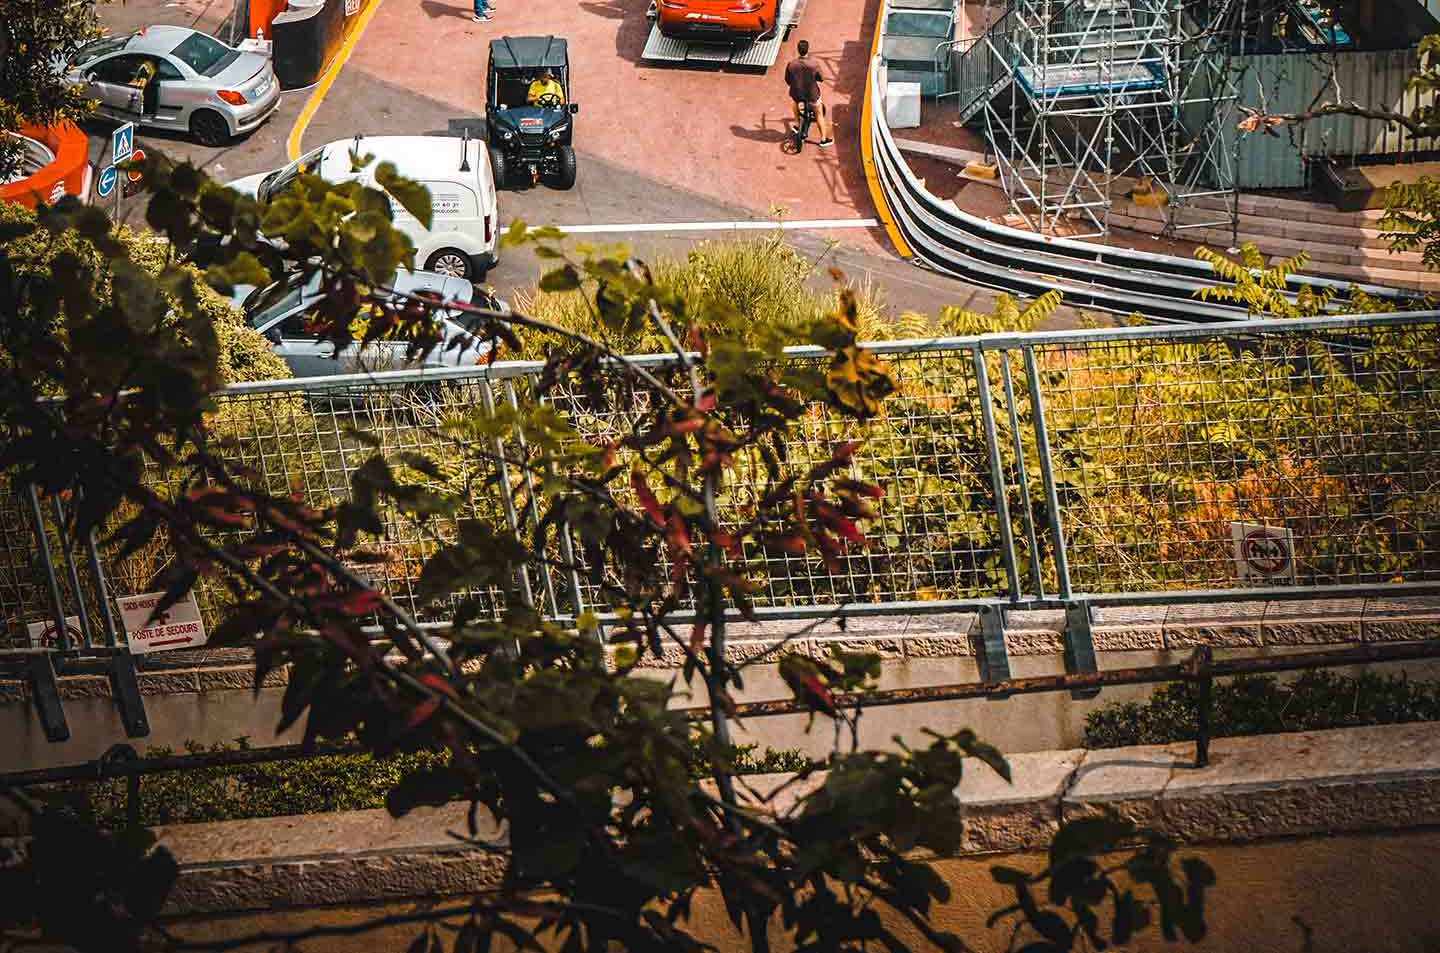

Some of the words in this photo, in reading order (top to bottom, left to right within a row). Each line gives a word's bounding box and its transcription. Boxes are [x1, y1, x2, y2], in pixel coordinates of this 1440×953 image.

[131, 630, 154, 641] POSTE
[155, 627, 166, 637] DE
[166, 623, 199, 636] SECOURS
